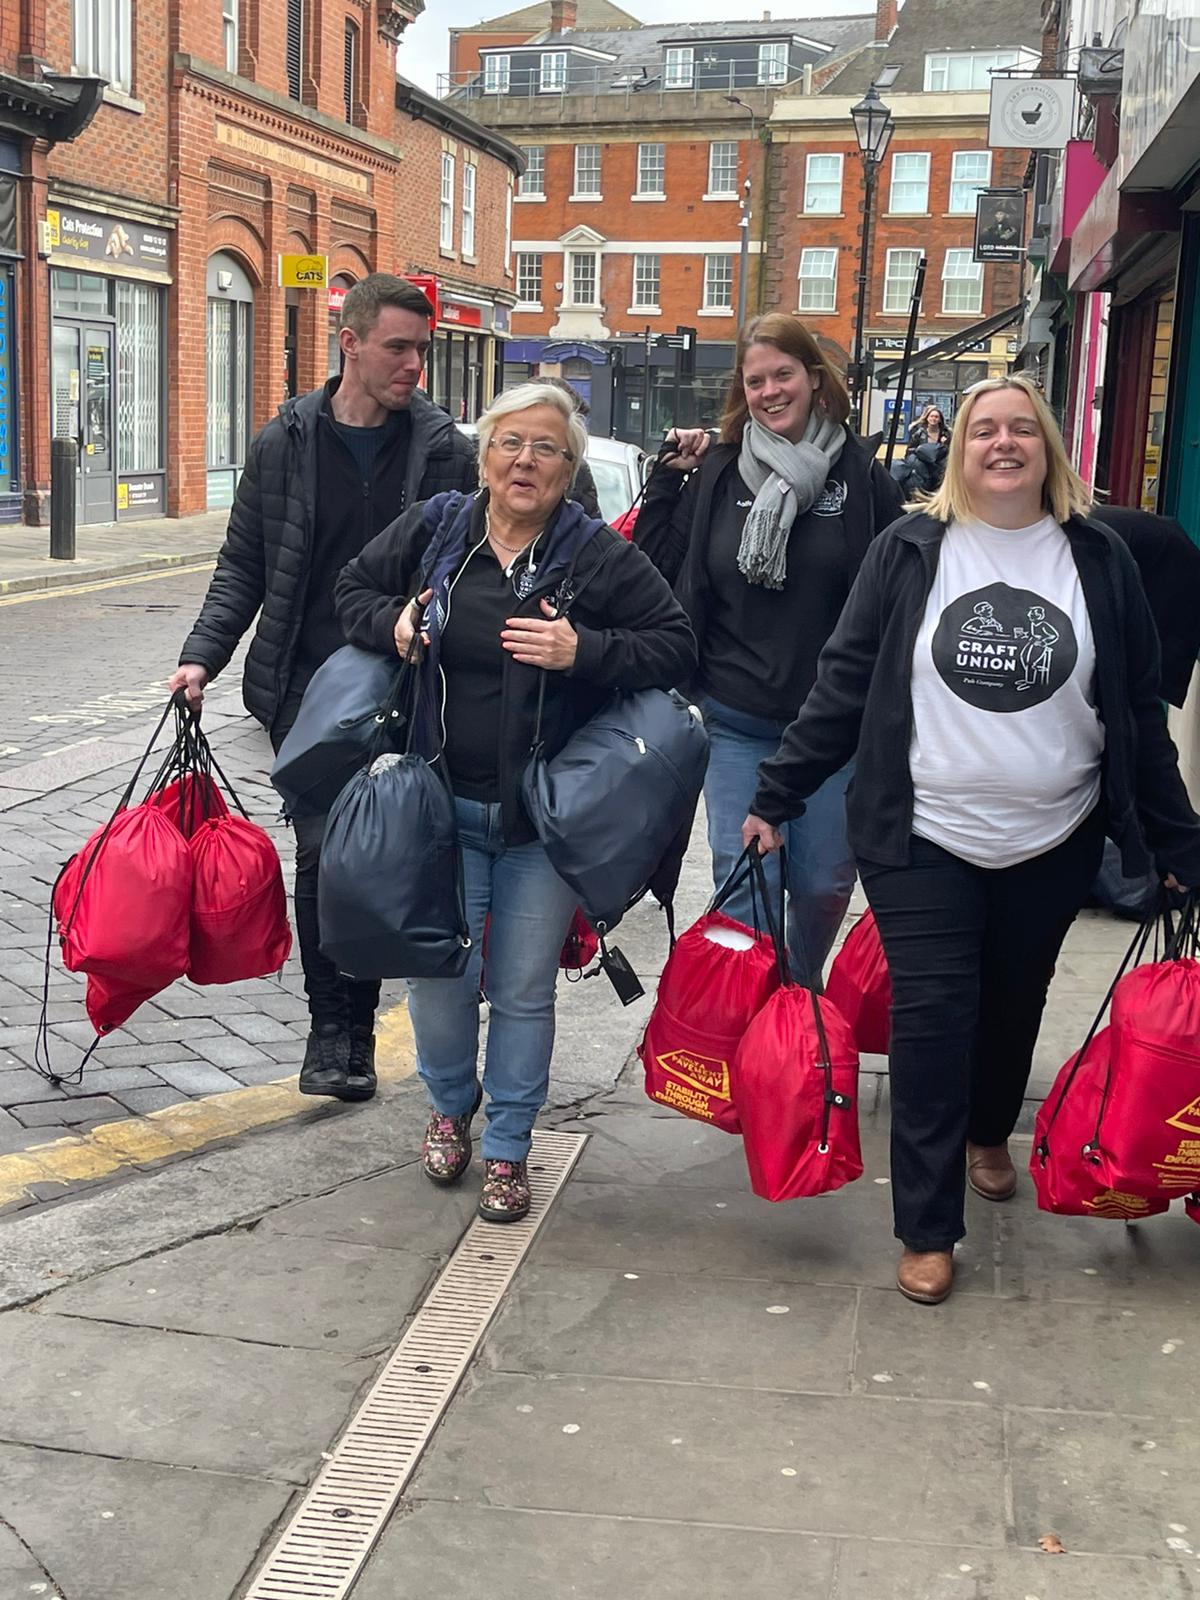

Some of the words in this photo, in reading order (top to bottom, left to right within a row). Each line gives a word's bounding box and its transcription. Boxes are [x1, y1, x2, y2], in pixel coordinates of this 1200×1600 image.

[62, 216, 75, 232] Cats
[75, 219, 103, 238] Protection
[296, 271, 324, 281] CATS
[958, 640, 1017, 656] CRAFT
[956, 654, 1016, 671] UNION
[671, 1054, 722, 1078] PAVEMENT
[689, 1072, 721, 1086] AWAY
[664, 1087, 709, 1110] THROUGH
[665, 1080, 711, 1102] STABILITY
[655, 1090, 715, 1119] EMPLOYMENT
